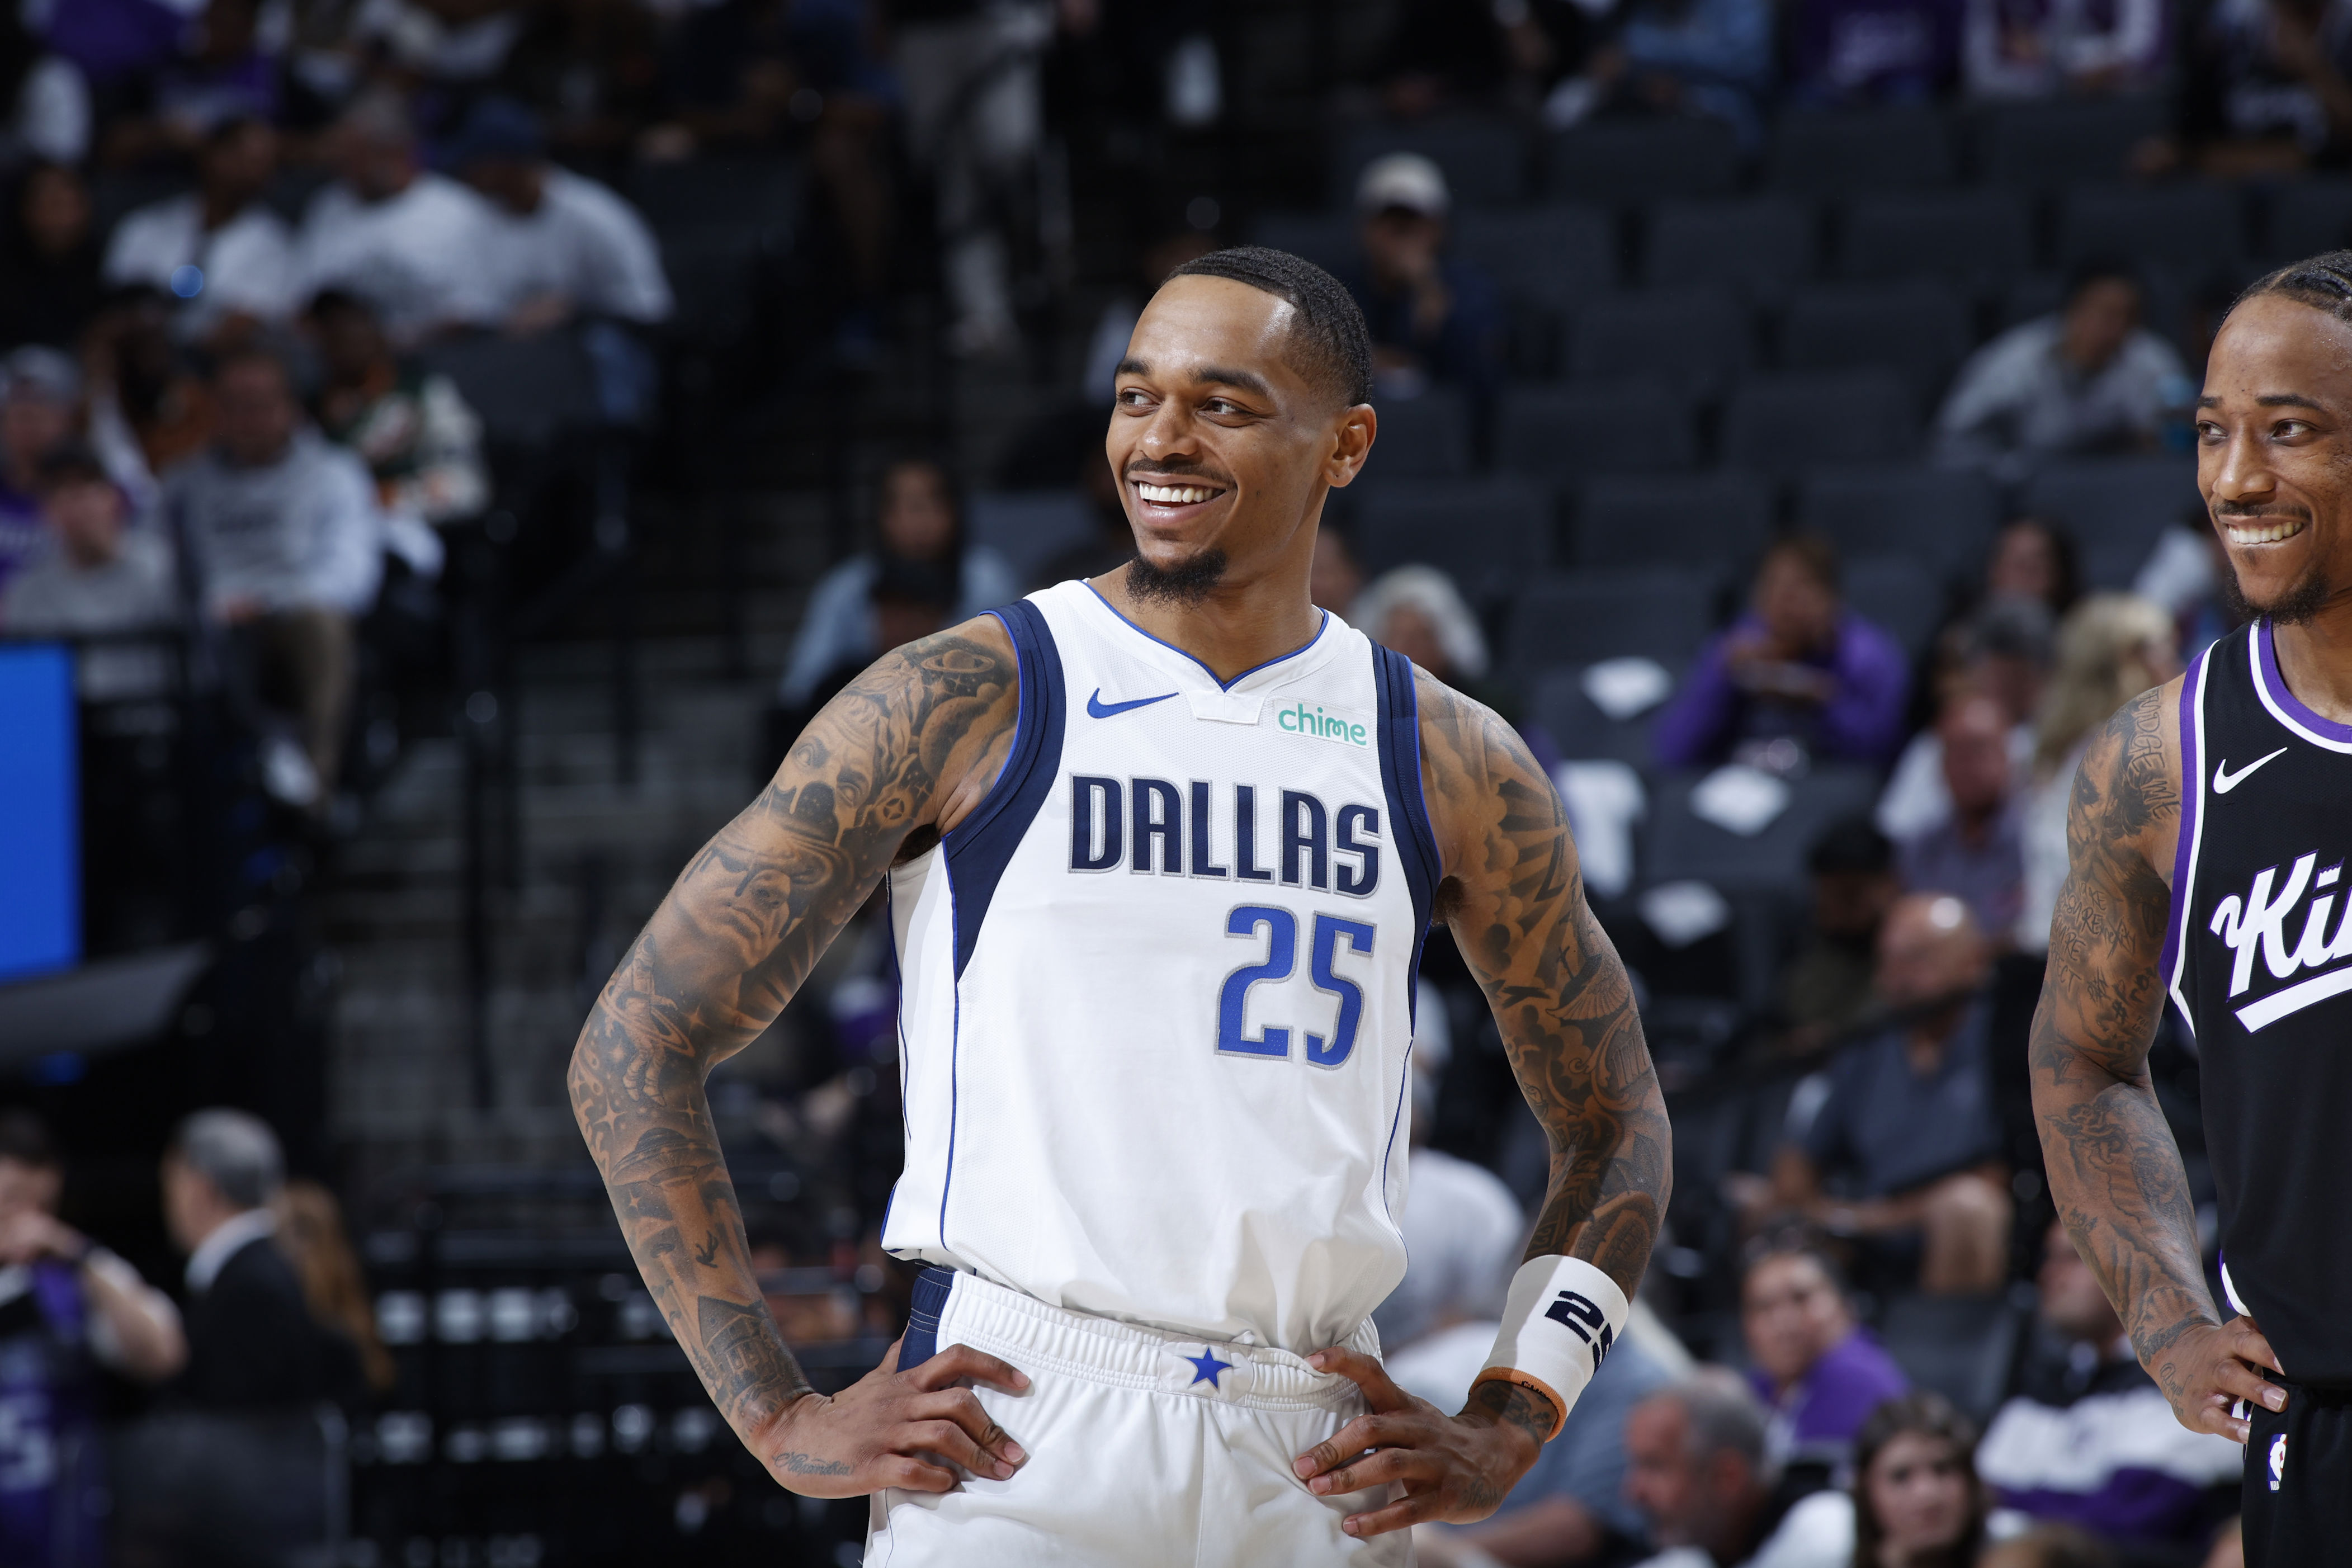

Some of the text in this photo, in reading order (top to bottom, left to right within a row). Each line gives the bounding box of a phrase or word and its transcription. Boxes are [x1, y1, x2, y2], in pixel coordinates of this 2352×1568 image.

[1278, 703, 1367, 746] chime
[1068, 772, 1382, 899] DALLAS
[1214, 902, 1377, 1071] 25
[2208, 848, 2352, 1003] Ki
[2270, 1480, 2280, 1491] NBA
